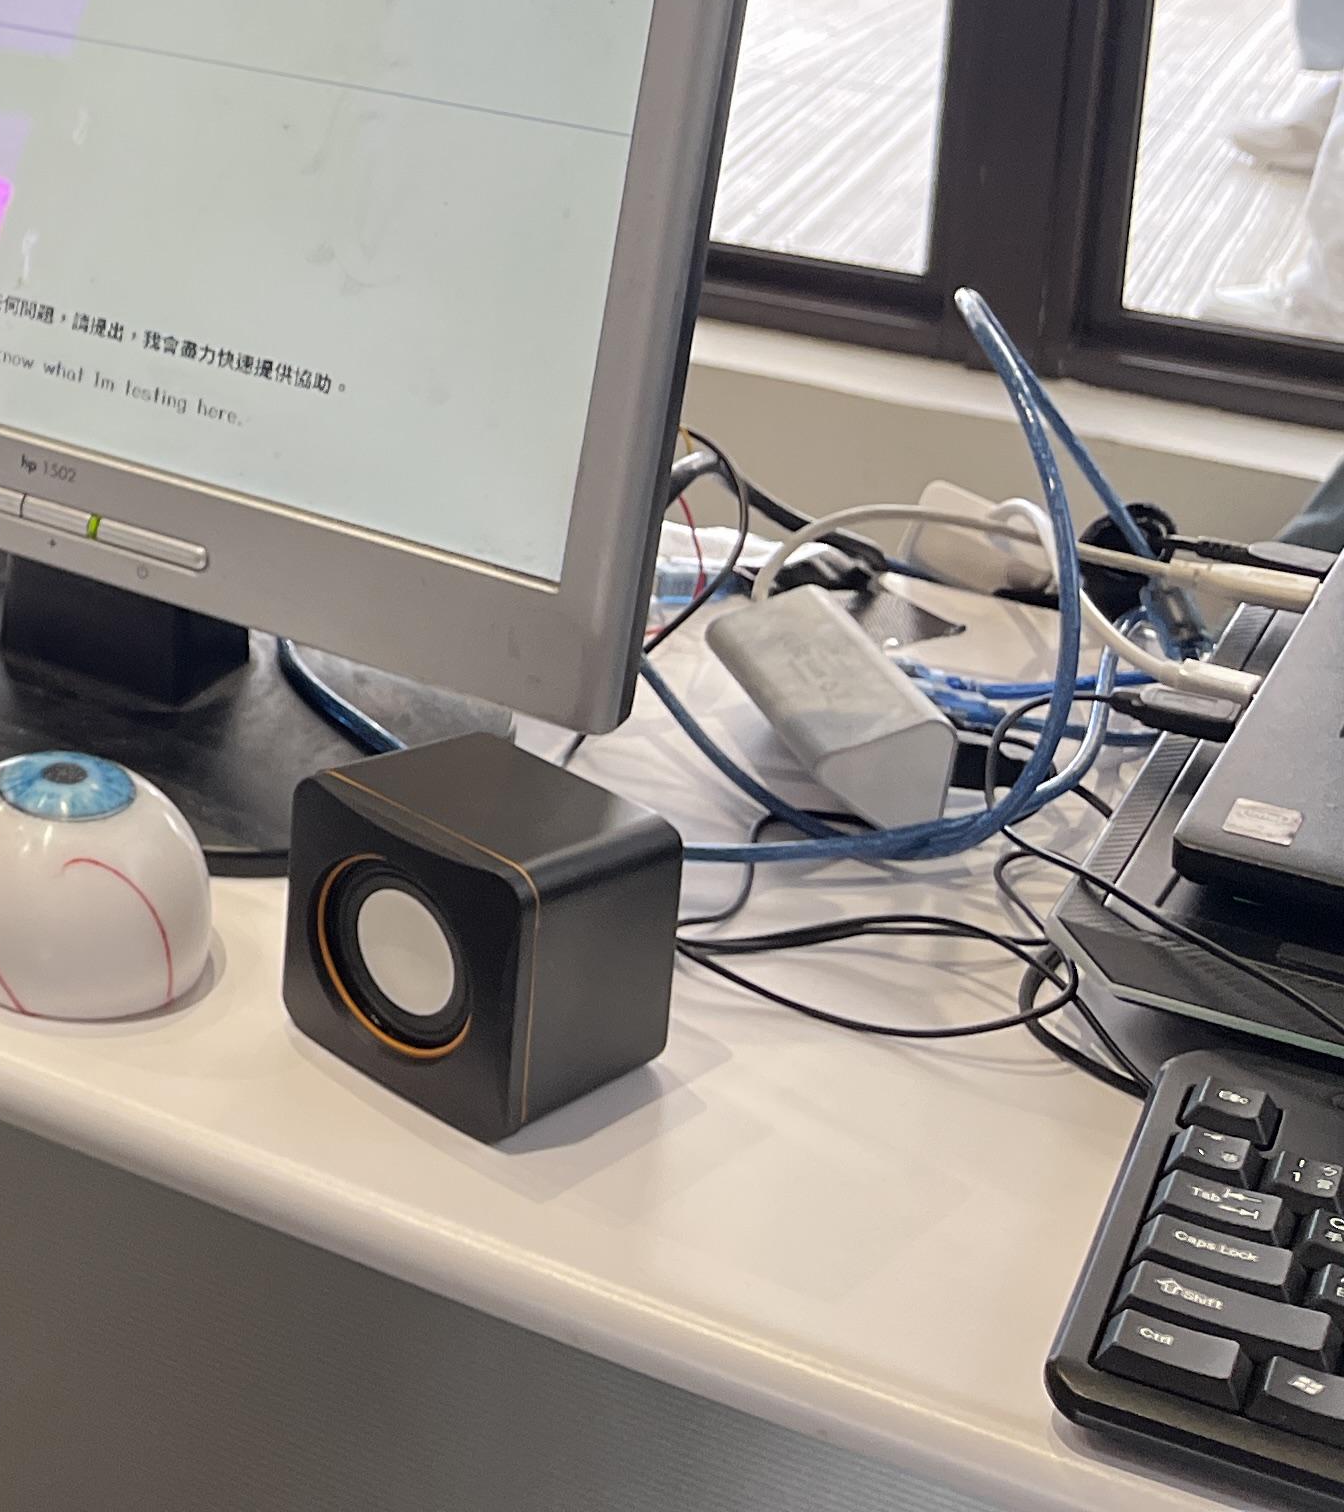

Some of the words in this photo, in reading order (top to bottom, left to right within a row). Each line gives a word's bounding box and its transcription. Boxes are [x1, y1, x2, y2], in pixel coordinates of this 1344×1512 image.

[43, 361, 83, 383] what
[94, 371, 115, 392] Im
[126, 380, 188, 415] testing
[197, 398, 243, 426] here.
[21, 454, 37, 472] hp
[43, 460, 78, 483] 1502
[1191, 1186, 1222, 1203] Tab
[1174, 1230, 1217, 1251] Caps
[1220, 1244, 1260, 1263] Lock
[1181, 1289, 1224, 1311] Shift
[1138, 1326, 1174, 1346] Ctrl
